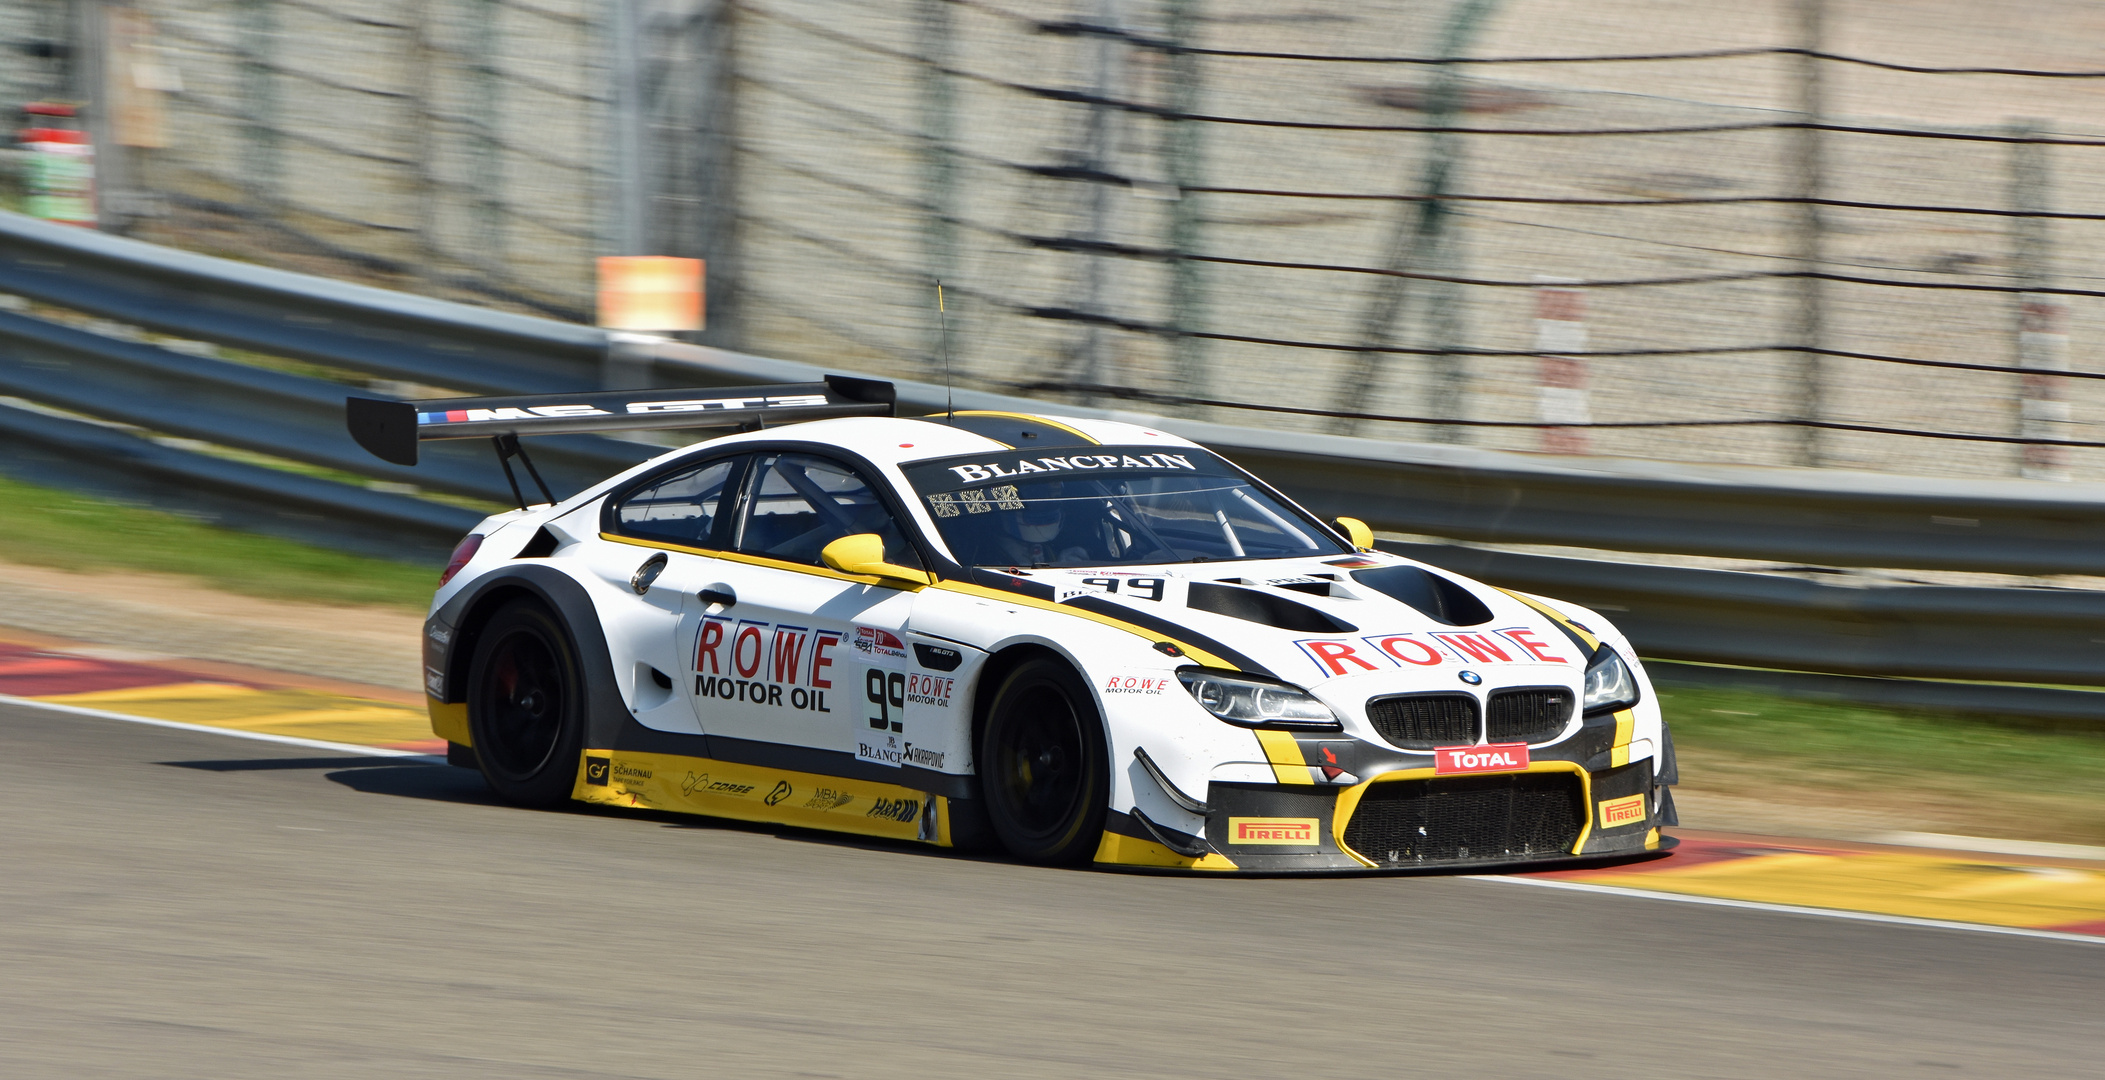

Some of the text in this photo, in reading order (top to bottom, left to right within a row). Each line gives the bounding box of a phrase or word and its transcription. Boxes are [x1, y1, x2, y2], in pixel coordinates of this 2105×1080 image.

[467, 394, 829, 421] M6 GT3
[949, 453, 1196, 483] BLANCPAIN
[693, 616, 844, 689] ROWE
[1291, 627, 1568, 678] ROWE
[695, 674, 830, 713] MOTOR OIL
[908, 672, 954, 699] ROWE
[1107, 675, 1169, 690] ROWE
[866, 668, 905, 733] 99
[907, 693, 949, 707] MOTOR OIL
[1449, 752, 1517, 768] TOTAL
[613, 765, 653, 779] SCHARNAU
[708, 781, 755, 794] CORSE
[814, 787, 837, 800] MBA
[1604, 800, 1642, 823] PIRELLI
[1238, 823, 1311, 840] PIRELLI
